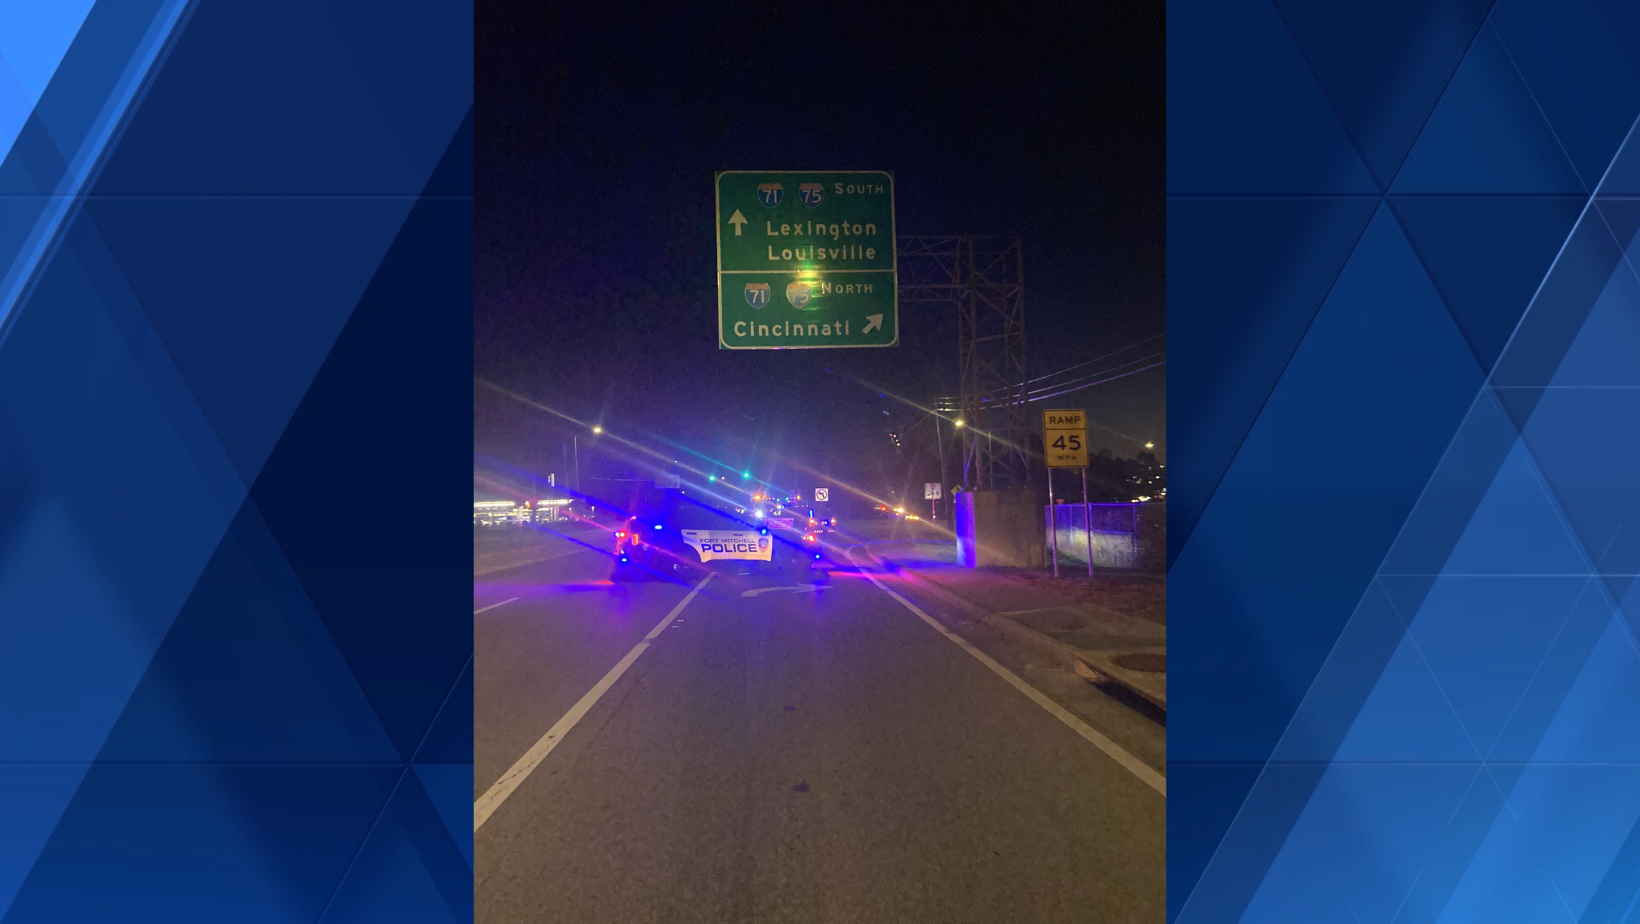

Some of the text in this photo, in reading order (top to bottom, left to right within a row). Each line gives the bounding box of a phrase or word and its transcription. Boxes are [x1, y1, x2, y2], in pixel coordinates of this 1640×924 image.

[763, 182, 884, 204] 71 75 SOUTH
[766, 220, 877, 241] Lexington
[768, 245, 876, 261] Louisville
[750, 290, 765, 304] 71
[821, 282, 873, 295] NORTH
[734, 320, 850, 337] Cincinnati
[1049, 416, 1081, 425] RAMP
[1052, 435, 1081, 450] 45
[701, 543, 758, 553] POLICE
